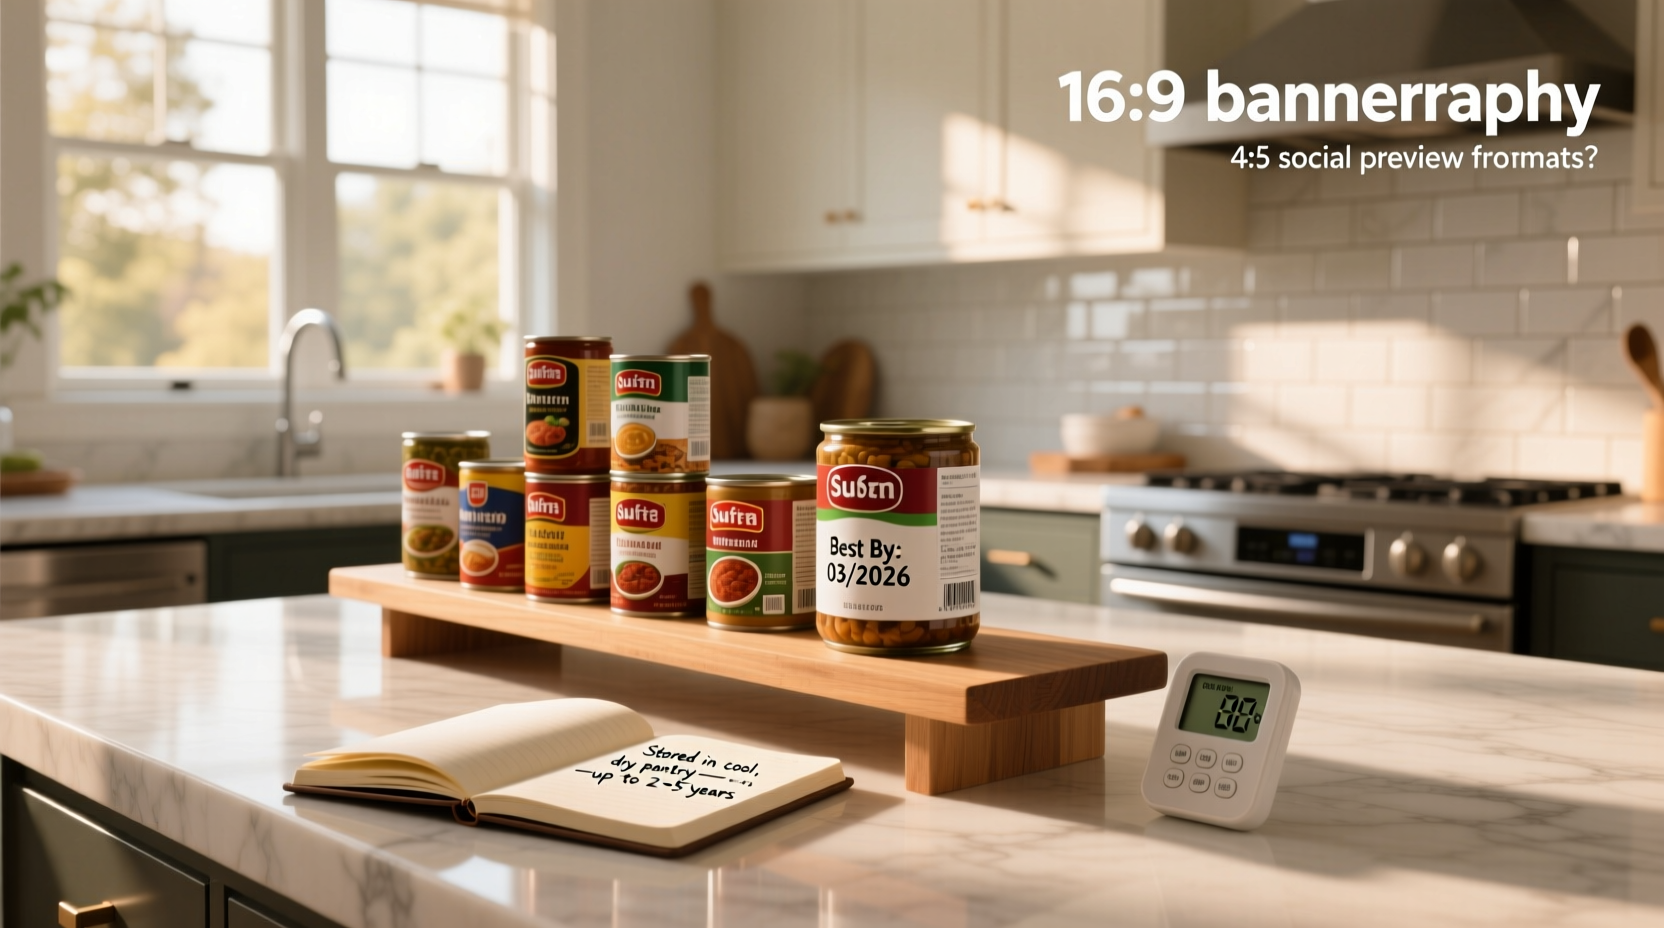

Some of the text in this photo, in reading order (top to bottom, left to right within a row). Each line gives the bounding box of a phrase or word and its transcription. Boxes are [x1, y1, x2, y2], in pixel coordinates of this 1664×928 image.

[830, 536, 902, 566] Best By:
[827, 562, 911, 588] 03/2026
[610, 755, 637, 772] dry
[642, 745, 759, 777] Stored in cool,
[620, 773, 640, 785] to
